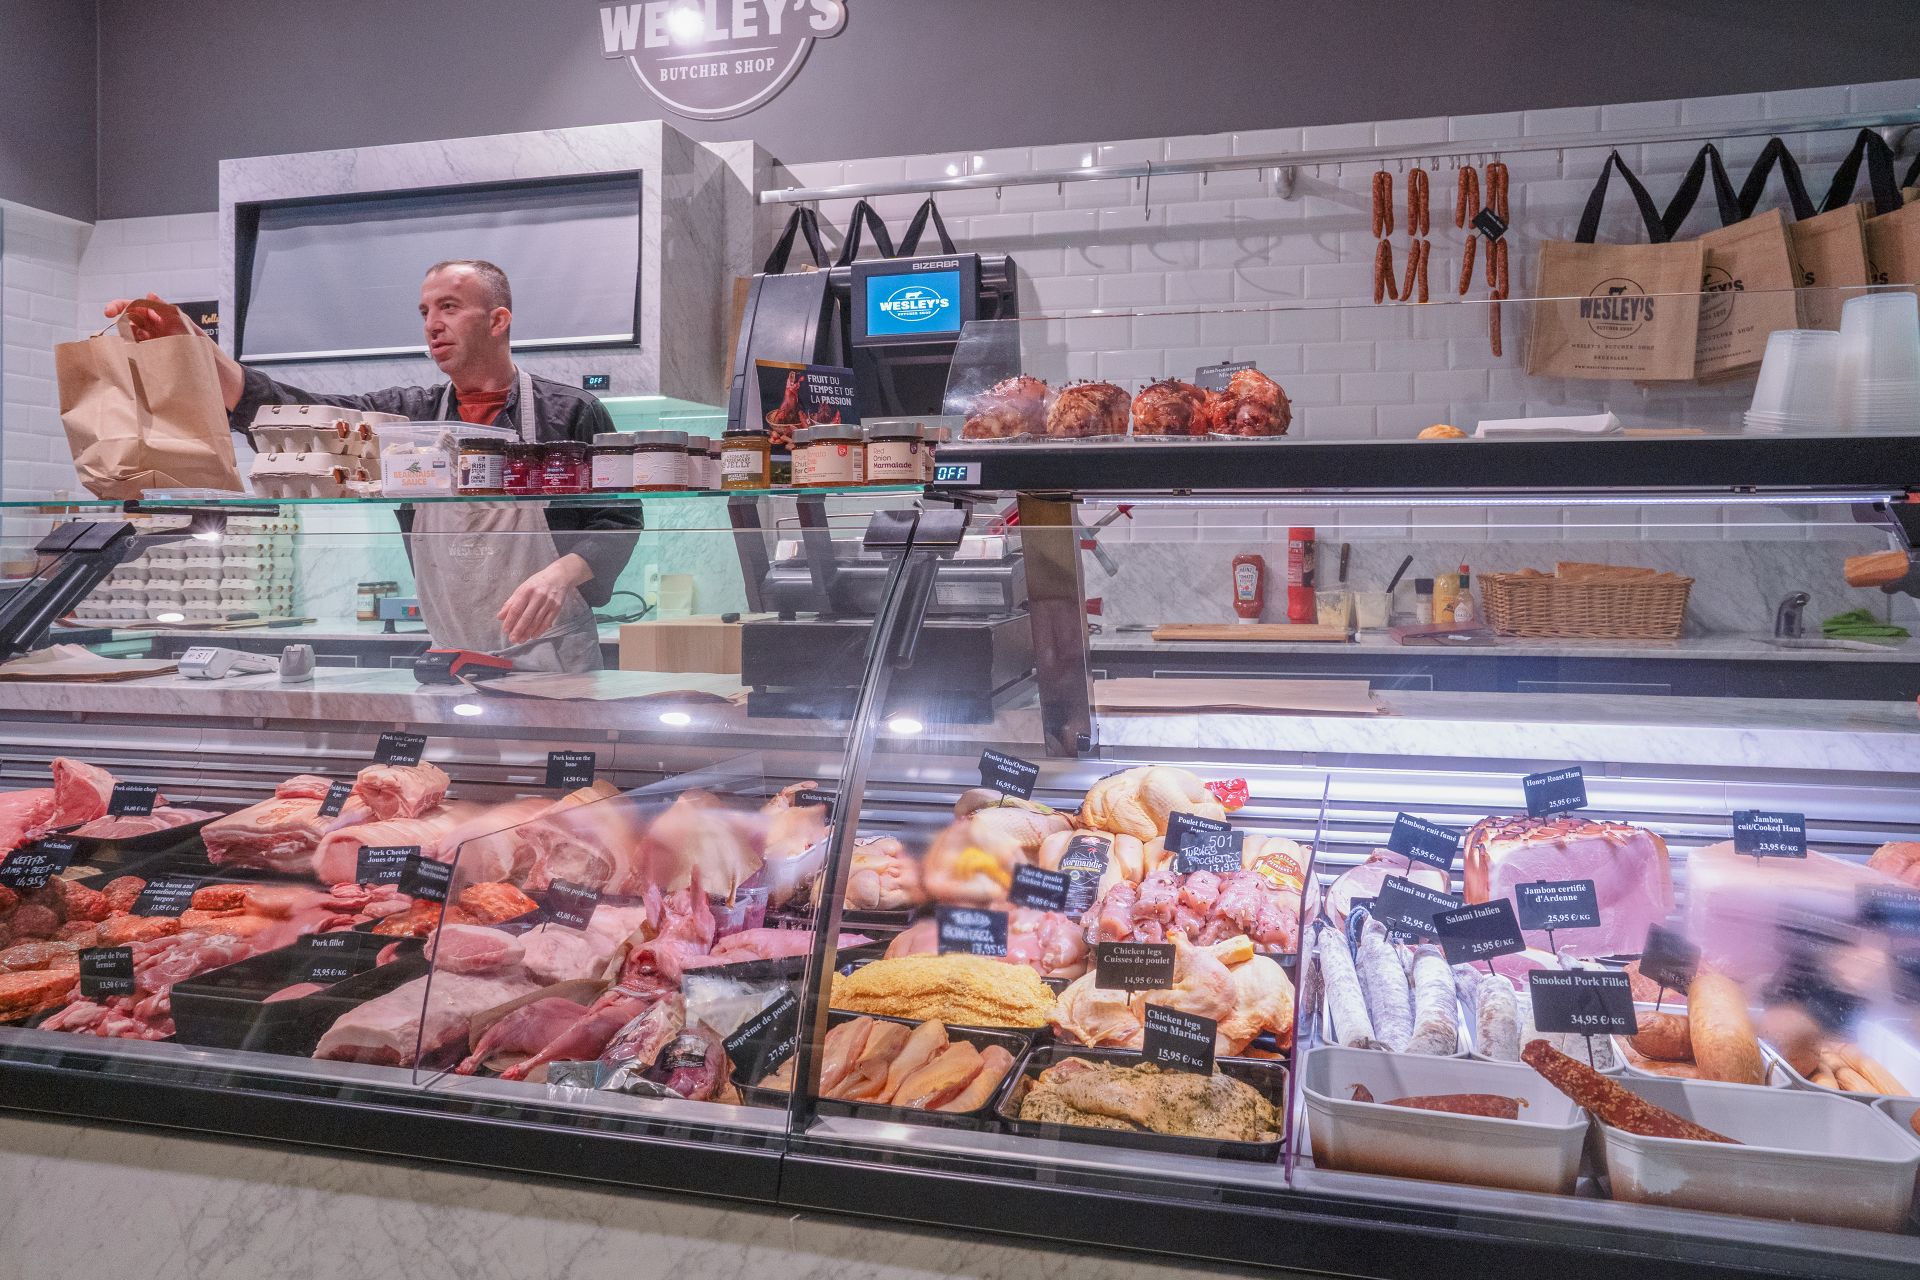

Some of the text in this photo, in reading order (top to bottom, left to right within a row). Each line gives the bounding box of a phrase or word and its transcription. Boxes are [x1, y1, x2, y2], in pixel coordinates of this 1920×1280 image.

[600, 0, 840, 52] WELEY'S
[659, 57, 776, 82] BUTCHER SHOP
[912, 260, 960, 270] BIZERBA
[880, 298, 950, 311] WESLEY'S
[1580, 297, 1654, 321] WESLEY'S
[807, 375, 840, 385] FRUIT DU
[809, 385, 855, 397] TEMPS ET DE
[811, 395, 852, 406] LA PASSION
[937, 467, 966, 480] OFF
[984, 751, 1037, 775] Poulet bio/Organic
[997, 764, 1020, 776] chicken
[996, 779, 1011, 790] 16,95
[1526, 771, 1580, 787] Honey Roast Ham
[802, 793, 822, 801] Chicken
[1549, 799, 1566, 808] 25,95
[1178, 816, 1198, 827] Poulet
[1199, 820, 1223, 831] fermier
[1753, 816, 1783, 824] Jambon
[1399, 817, 1457, 842] Jambon cuit fumé
[1738, 824, 1801, 833] cuit/Cooked Ham
[1209, 835, 1233, 848] 501
[1759, 843, 1779, 851] 23,95
[1410, 847, 1429, 860] 25,95
[31, 863, 54, 874] BEEF
[1062, 857, 1103, 870] Normandie
[1017, 875, 1063, 891] Chicken breasts
[1043, 873, 1063, 884] poulet
[1386, 880, 1459, 909] Salami au Fenouil
[1524, 884, 1586, 895] Jambon certifié
[1535, 894, 1577, 903] d'Ardenne
[1445, 906, 1501, 925] Salami Italien
[1547, 914, 1569, 923] 25,95
[1401, 915, 1423, 929] 32,95
[1113, 946, 1162, 957] Chicken legs
[1472, 941, 1494, 953] 25,95
[96, 960, 117, 969] fermier
[1104, 955, 1170, 966] Cuisses de poulet
[1124, 976, 1144, 985] 14,95
[1532, 975, 1629, 987] Smoked Pork Fillet
[727, 996, 798, 1051] Suprême de poulet
[1147, 1009, 1201, 1031] Chicken legs
[1571, 1014, 1599, 1025] 34,95
[1145, 1020, 1210, 1044] uisses Marinées
[768, 1042, 790, 1062] 27,95
[1158, 1048, 1180, 1061] 15,95
